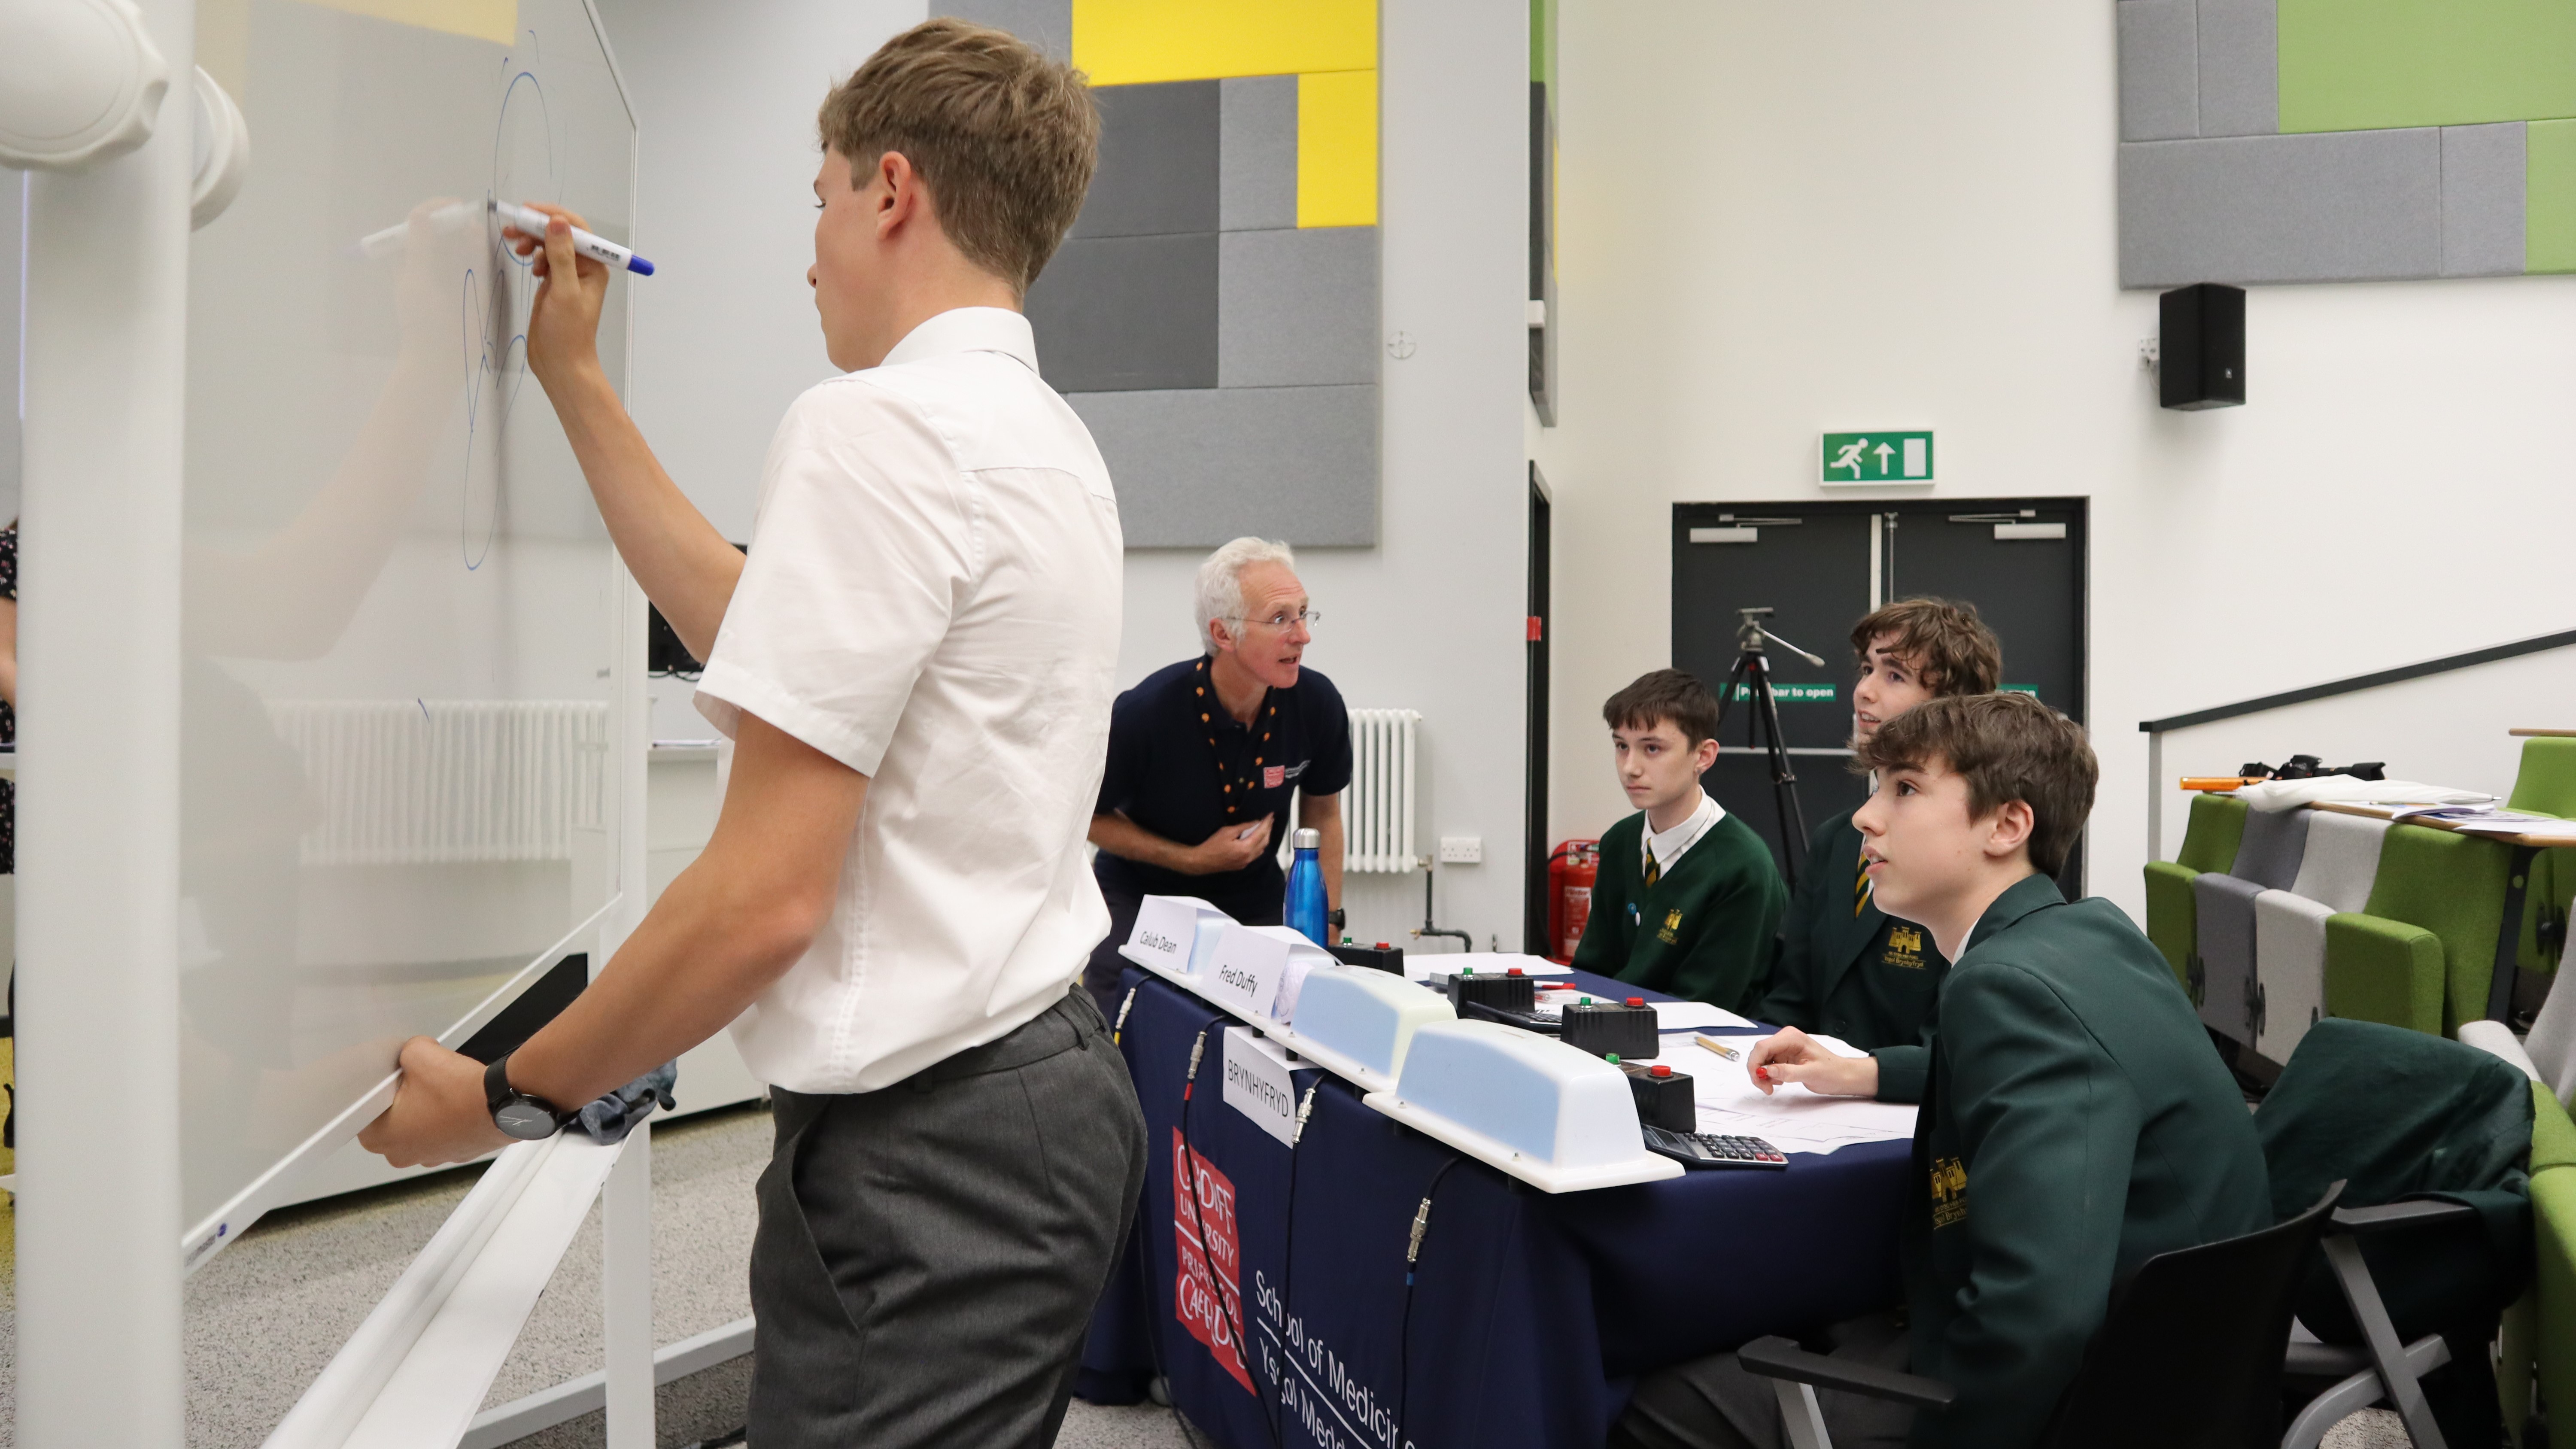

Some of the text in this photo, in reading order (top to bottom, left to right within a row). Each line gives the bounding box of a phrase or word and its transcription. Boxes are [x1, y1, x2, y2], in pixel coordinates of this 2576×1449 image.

[1792, 687, 1804, 697] to
[1806, 689, 1834, 699] open
[1158, 936, 1177, 954] Dean
[1219, 964, 1258, 998] Fred Duffy
[1228, 1059, 1288, 1118] BRYNHYFRYD
[1180, 1193, 1235, 1268] UNRSITY
[1308, 1338, 1323, 1375] of
